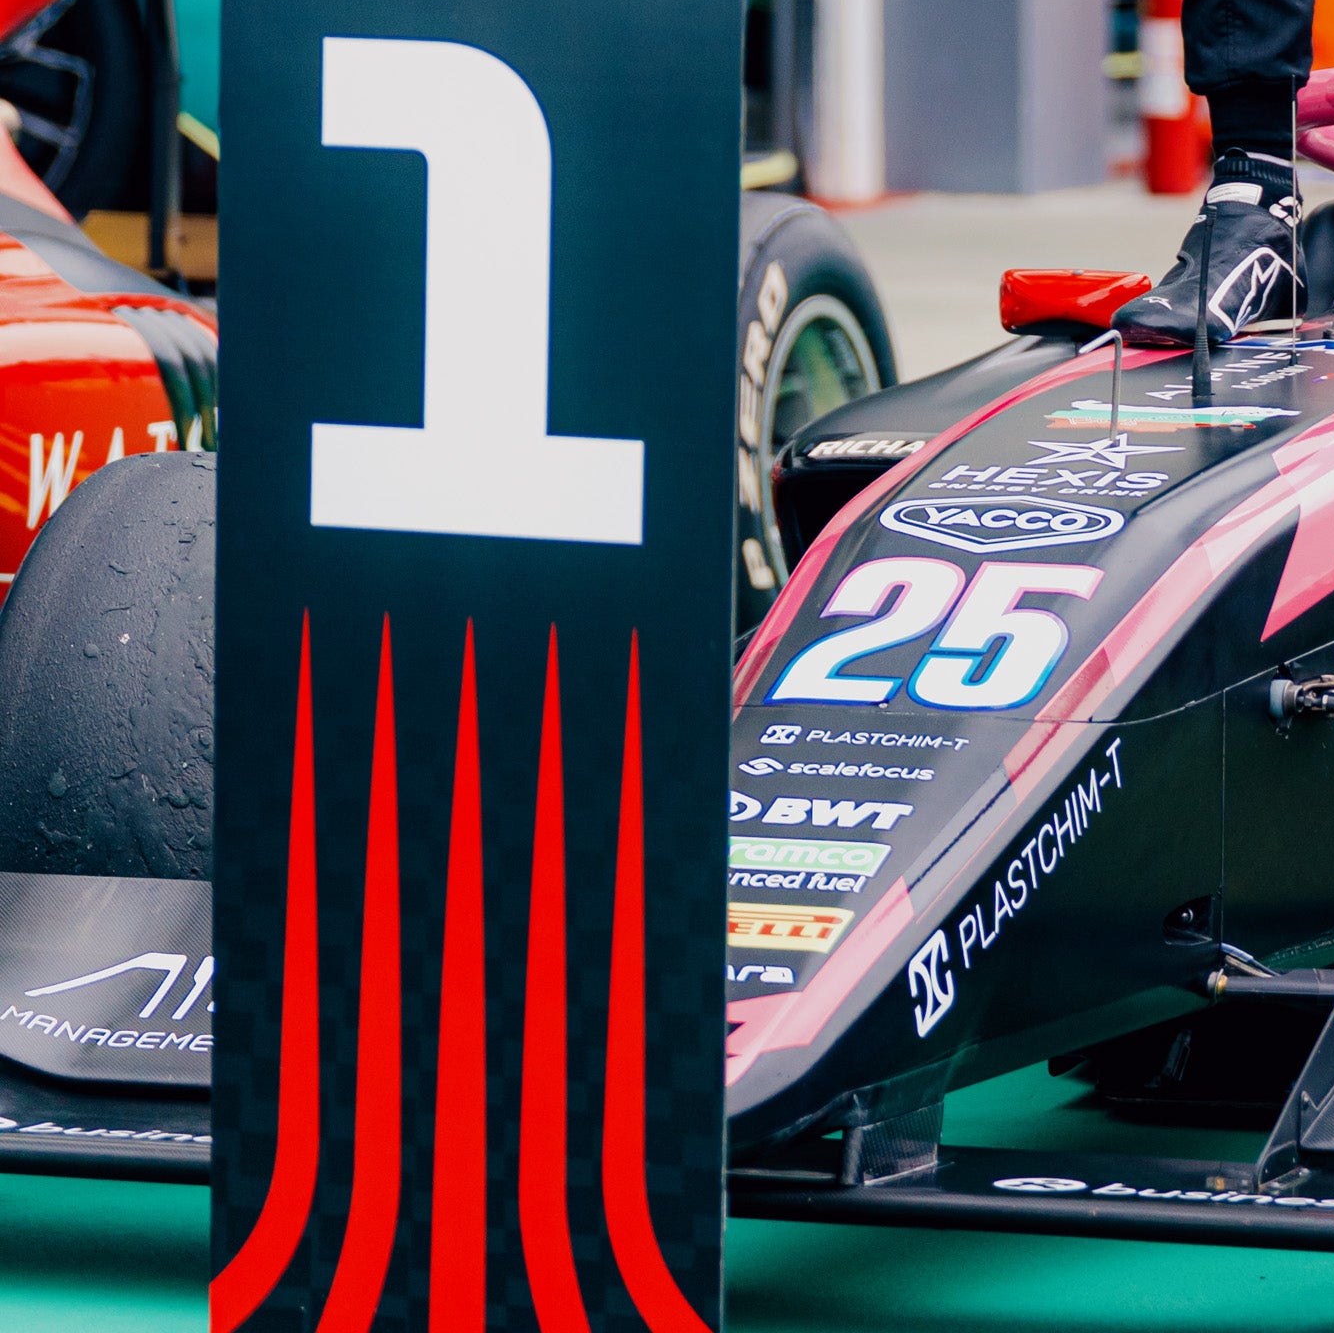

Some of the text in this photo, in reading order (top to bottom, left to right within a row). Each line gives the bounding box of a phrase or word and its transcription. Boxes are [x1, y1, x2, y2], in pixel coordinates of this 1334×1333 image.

[311, 36, 645, 546] 1
[809, 438, 926, 459] RICHA
[941, 464, 1169, 489] HEXIS
[928, 481, 1152, 498] ENERGY DRINK
[921, 507, 1090, 533] YACCO
[764, 557, 1105, 711] 25
[806, 729, 969, 752] PLASTCHIM-T
[787, 762, 935, 781] scalefocus
[762, 797, 914, 829] BWT
[729, 843, 875, 867] ramco
[959, 737, 1122, 969] PLASTCHIM-T
[729, 872, 866, 893] nced fuel
[728, 909, 843, 940] ELLI
[0, 1005, 214, 1053] MANAGEME
